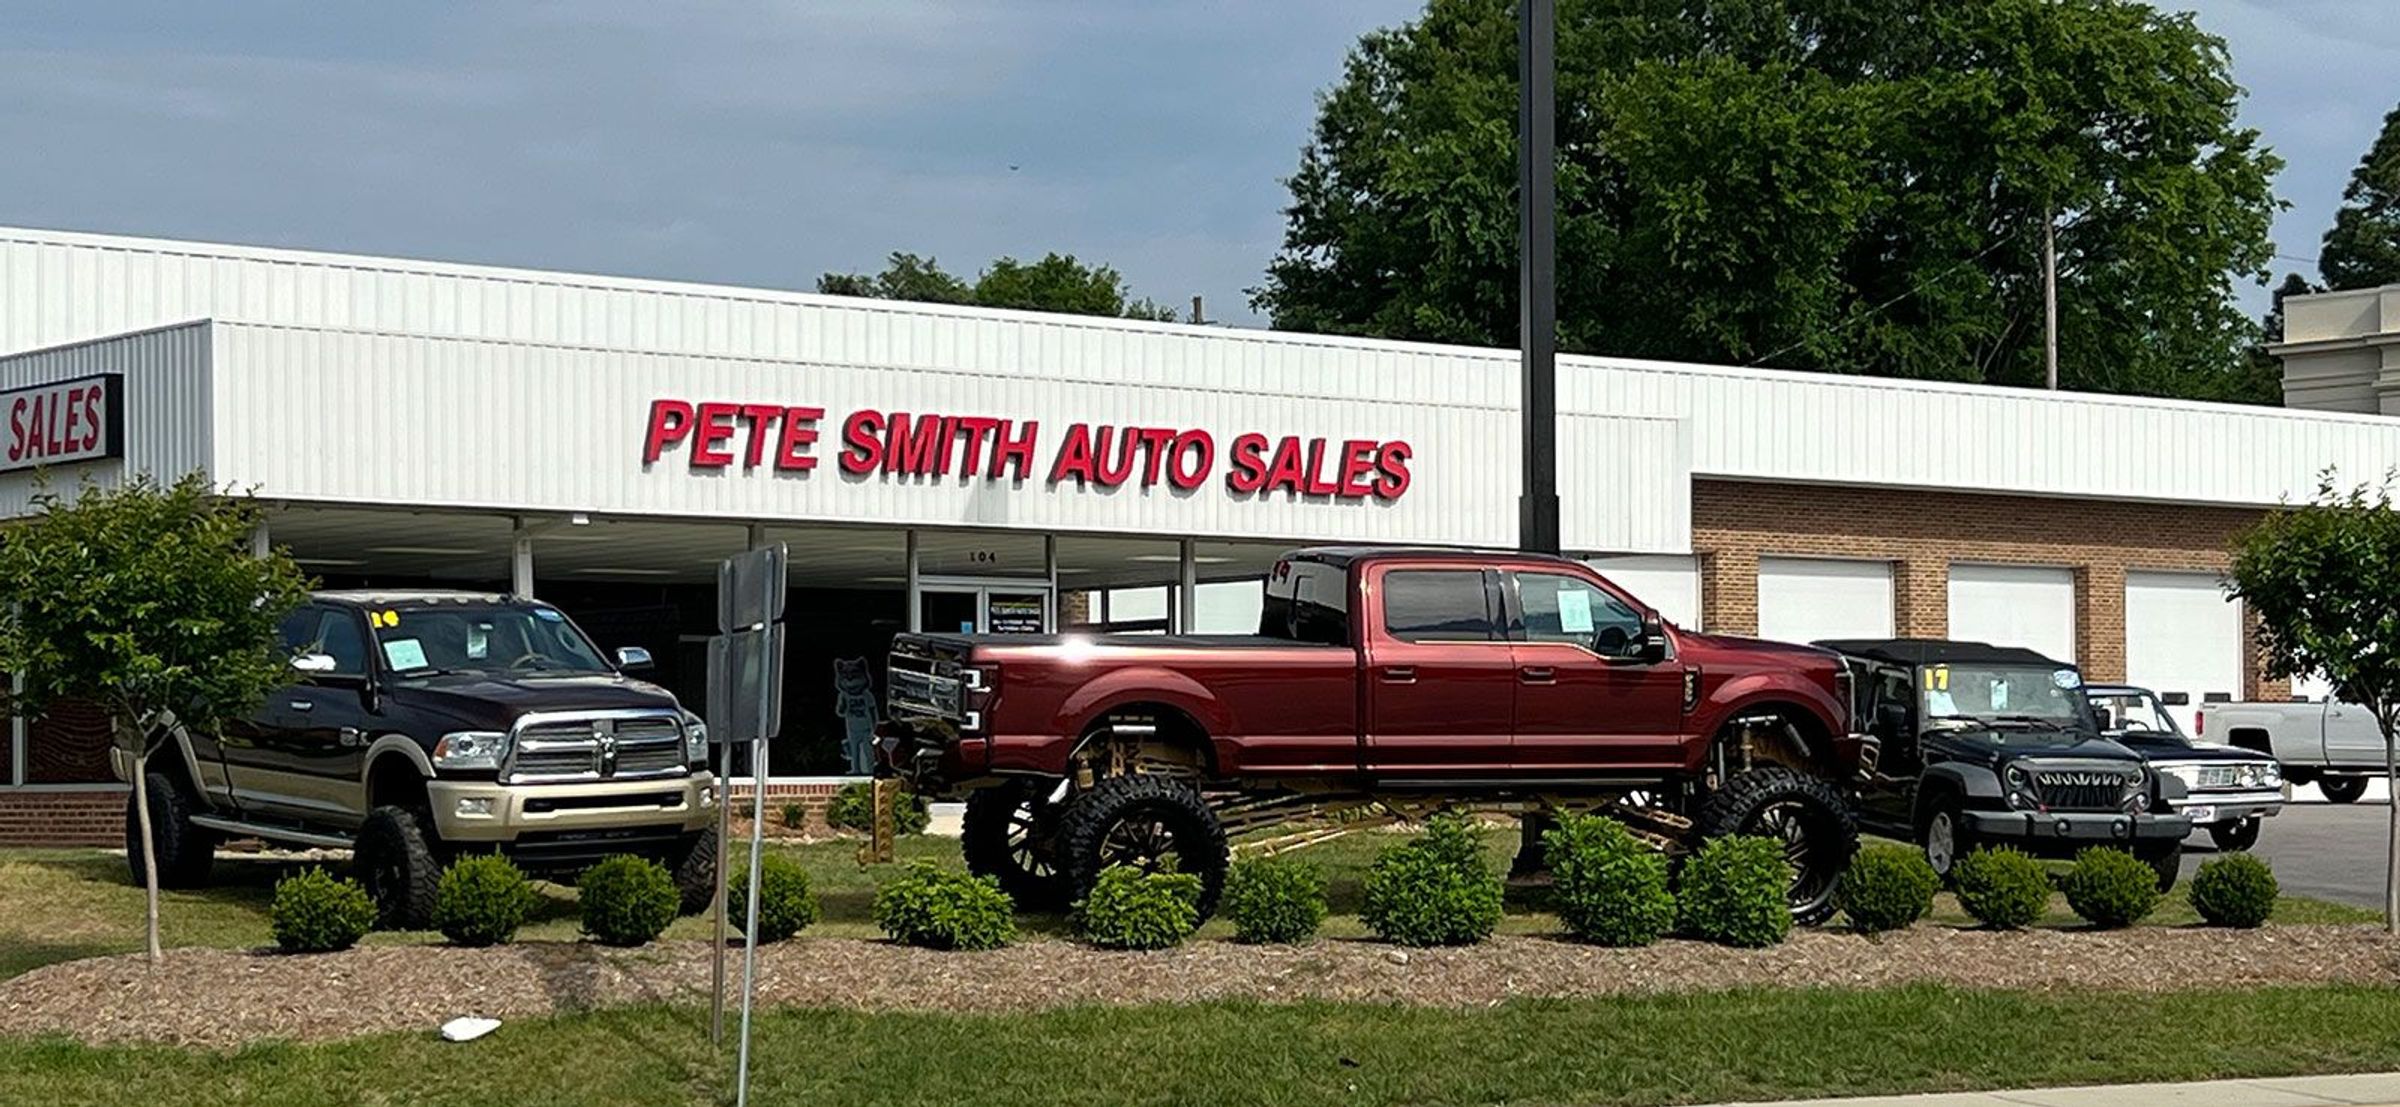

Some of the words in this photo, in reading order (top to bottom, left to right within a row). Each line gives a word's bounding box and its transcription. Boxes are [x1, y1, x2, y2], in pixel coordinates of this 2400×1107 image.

[8, 384, 103, 462] SALES
[644, 399, 825, 471] PETE
[839, 410, 1040, 481] SMITH
[1048, 423, 1216, 491] AUTO
[1227, 433, 1413, 501] SALES
[969, 551, 996, 563] 104
[1924, 664, 1950, 692] 17
